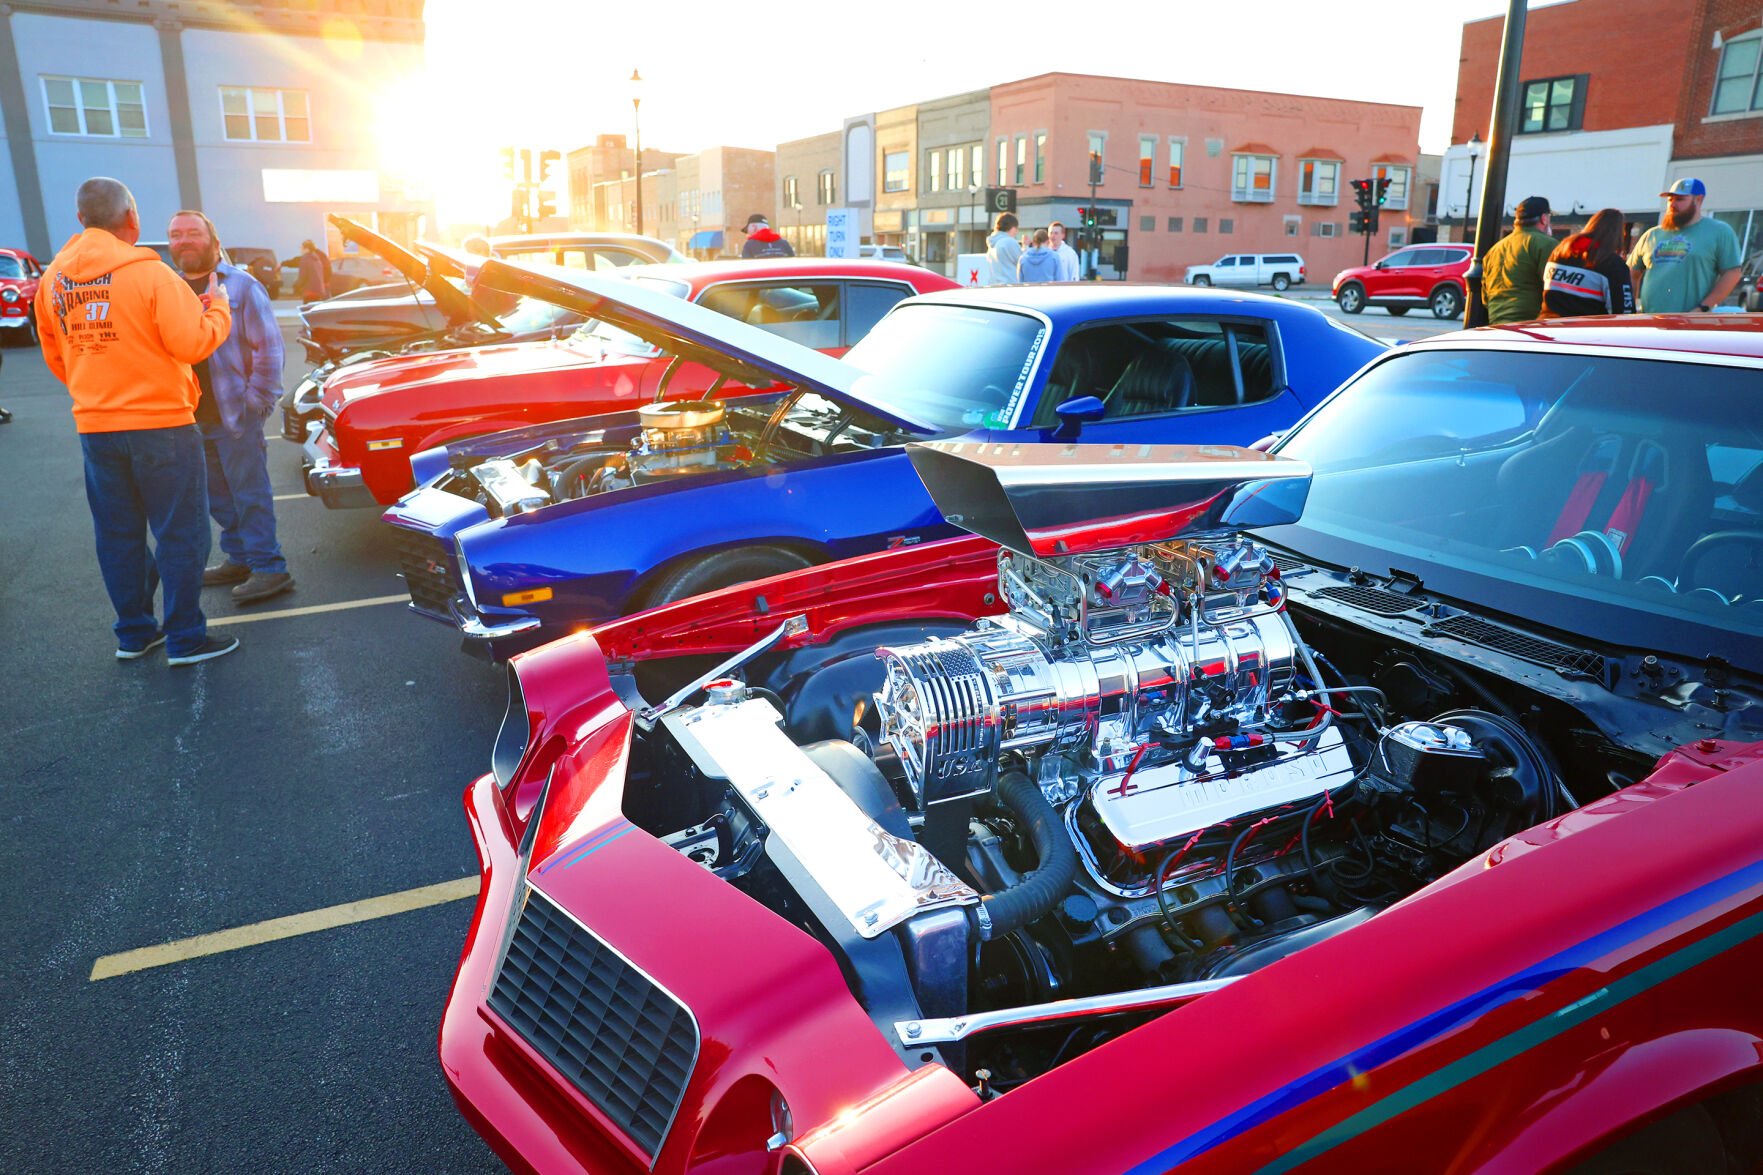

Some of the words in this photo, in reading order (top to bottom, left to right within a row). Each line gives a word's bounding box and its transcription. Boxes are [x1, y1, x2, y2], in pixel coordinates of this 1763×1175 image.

[828, 214, 846, 226] RIGHT
[829, 231, 845, 242] TURN
[829, 246, 845, 258] ONLY
[1546, 267, 1585, 286] SEMA
[66, 290, 109, 312] RACING
[86, 301, 110, 321] 37
[72, 323, 86, 331] HILL
[89, 321, 112, 329] CLIMB
[1002, 381, 1024, 424] POWER
[1018, 351, 1036, 381] TOUR
[1030, 328, 1046, 352] 2015
[939, 758, 982, 779] USA
